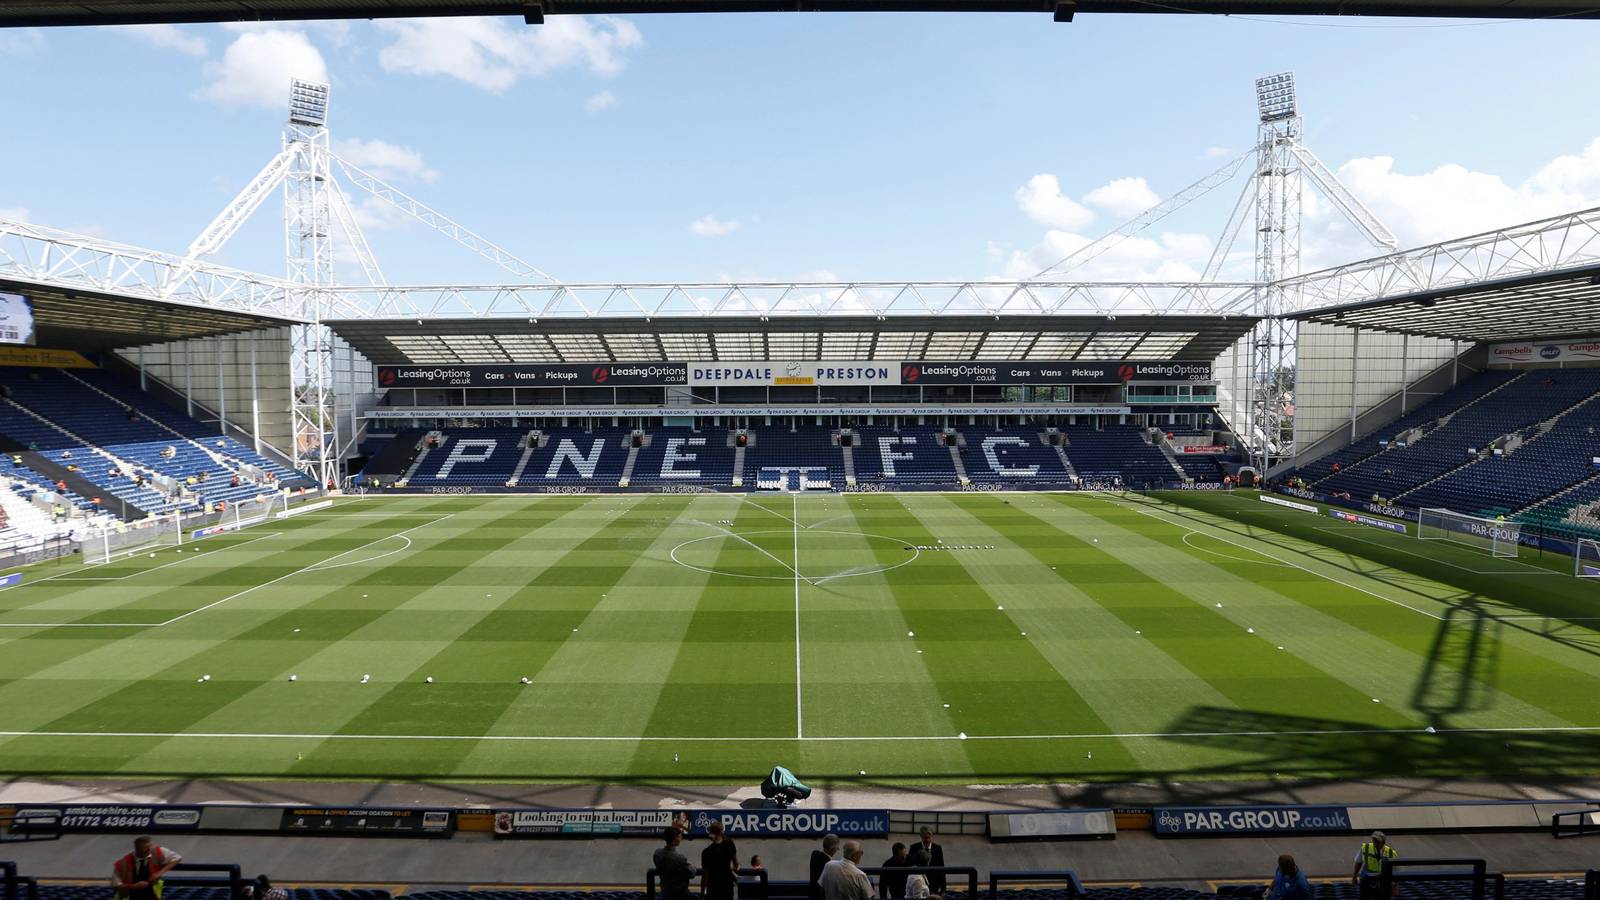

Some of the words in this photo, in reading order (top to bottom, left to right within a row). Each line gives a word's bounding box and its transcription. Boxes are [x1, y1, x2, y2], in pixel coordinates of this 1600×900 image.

[398, 368, 471, 380] LeasingOptions
[484, 372, 504, 380] Cars
[545, 371, 578, 380] Pickups
[610, 366, 686, 378] LeasingOptions
[694, 368, 772, 380] DEEPDALE
[817, 368, 888, 380] PRESTON
[922, 365, 997, 376] LeasingOptions
[1010, 369, 1030, 377] Cars
[1040, 369, 1062, 377] Vans
[1072, 368, 1104, 378] Pickups
[1136, 364, 1210, 376] LeasingOptions
[65, 806, 152, 815] ambrosehire.com
[61, 816, 100, 826] 01772
[518, 812, 563, 824] Looking
[565, 812, 576, 823] to
[580, 813, 602, 822] run
[602, 814, 609, 822] a
[612, 812, 640, 823] local
[641, 812, 668, 825] pub?
[721, 814, 884, 832] PAR-GROUP.co.uk
[1184, 811, 1346, 830] PAR-GROUP.co.uk
